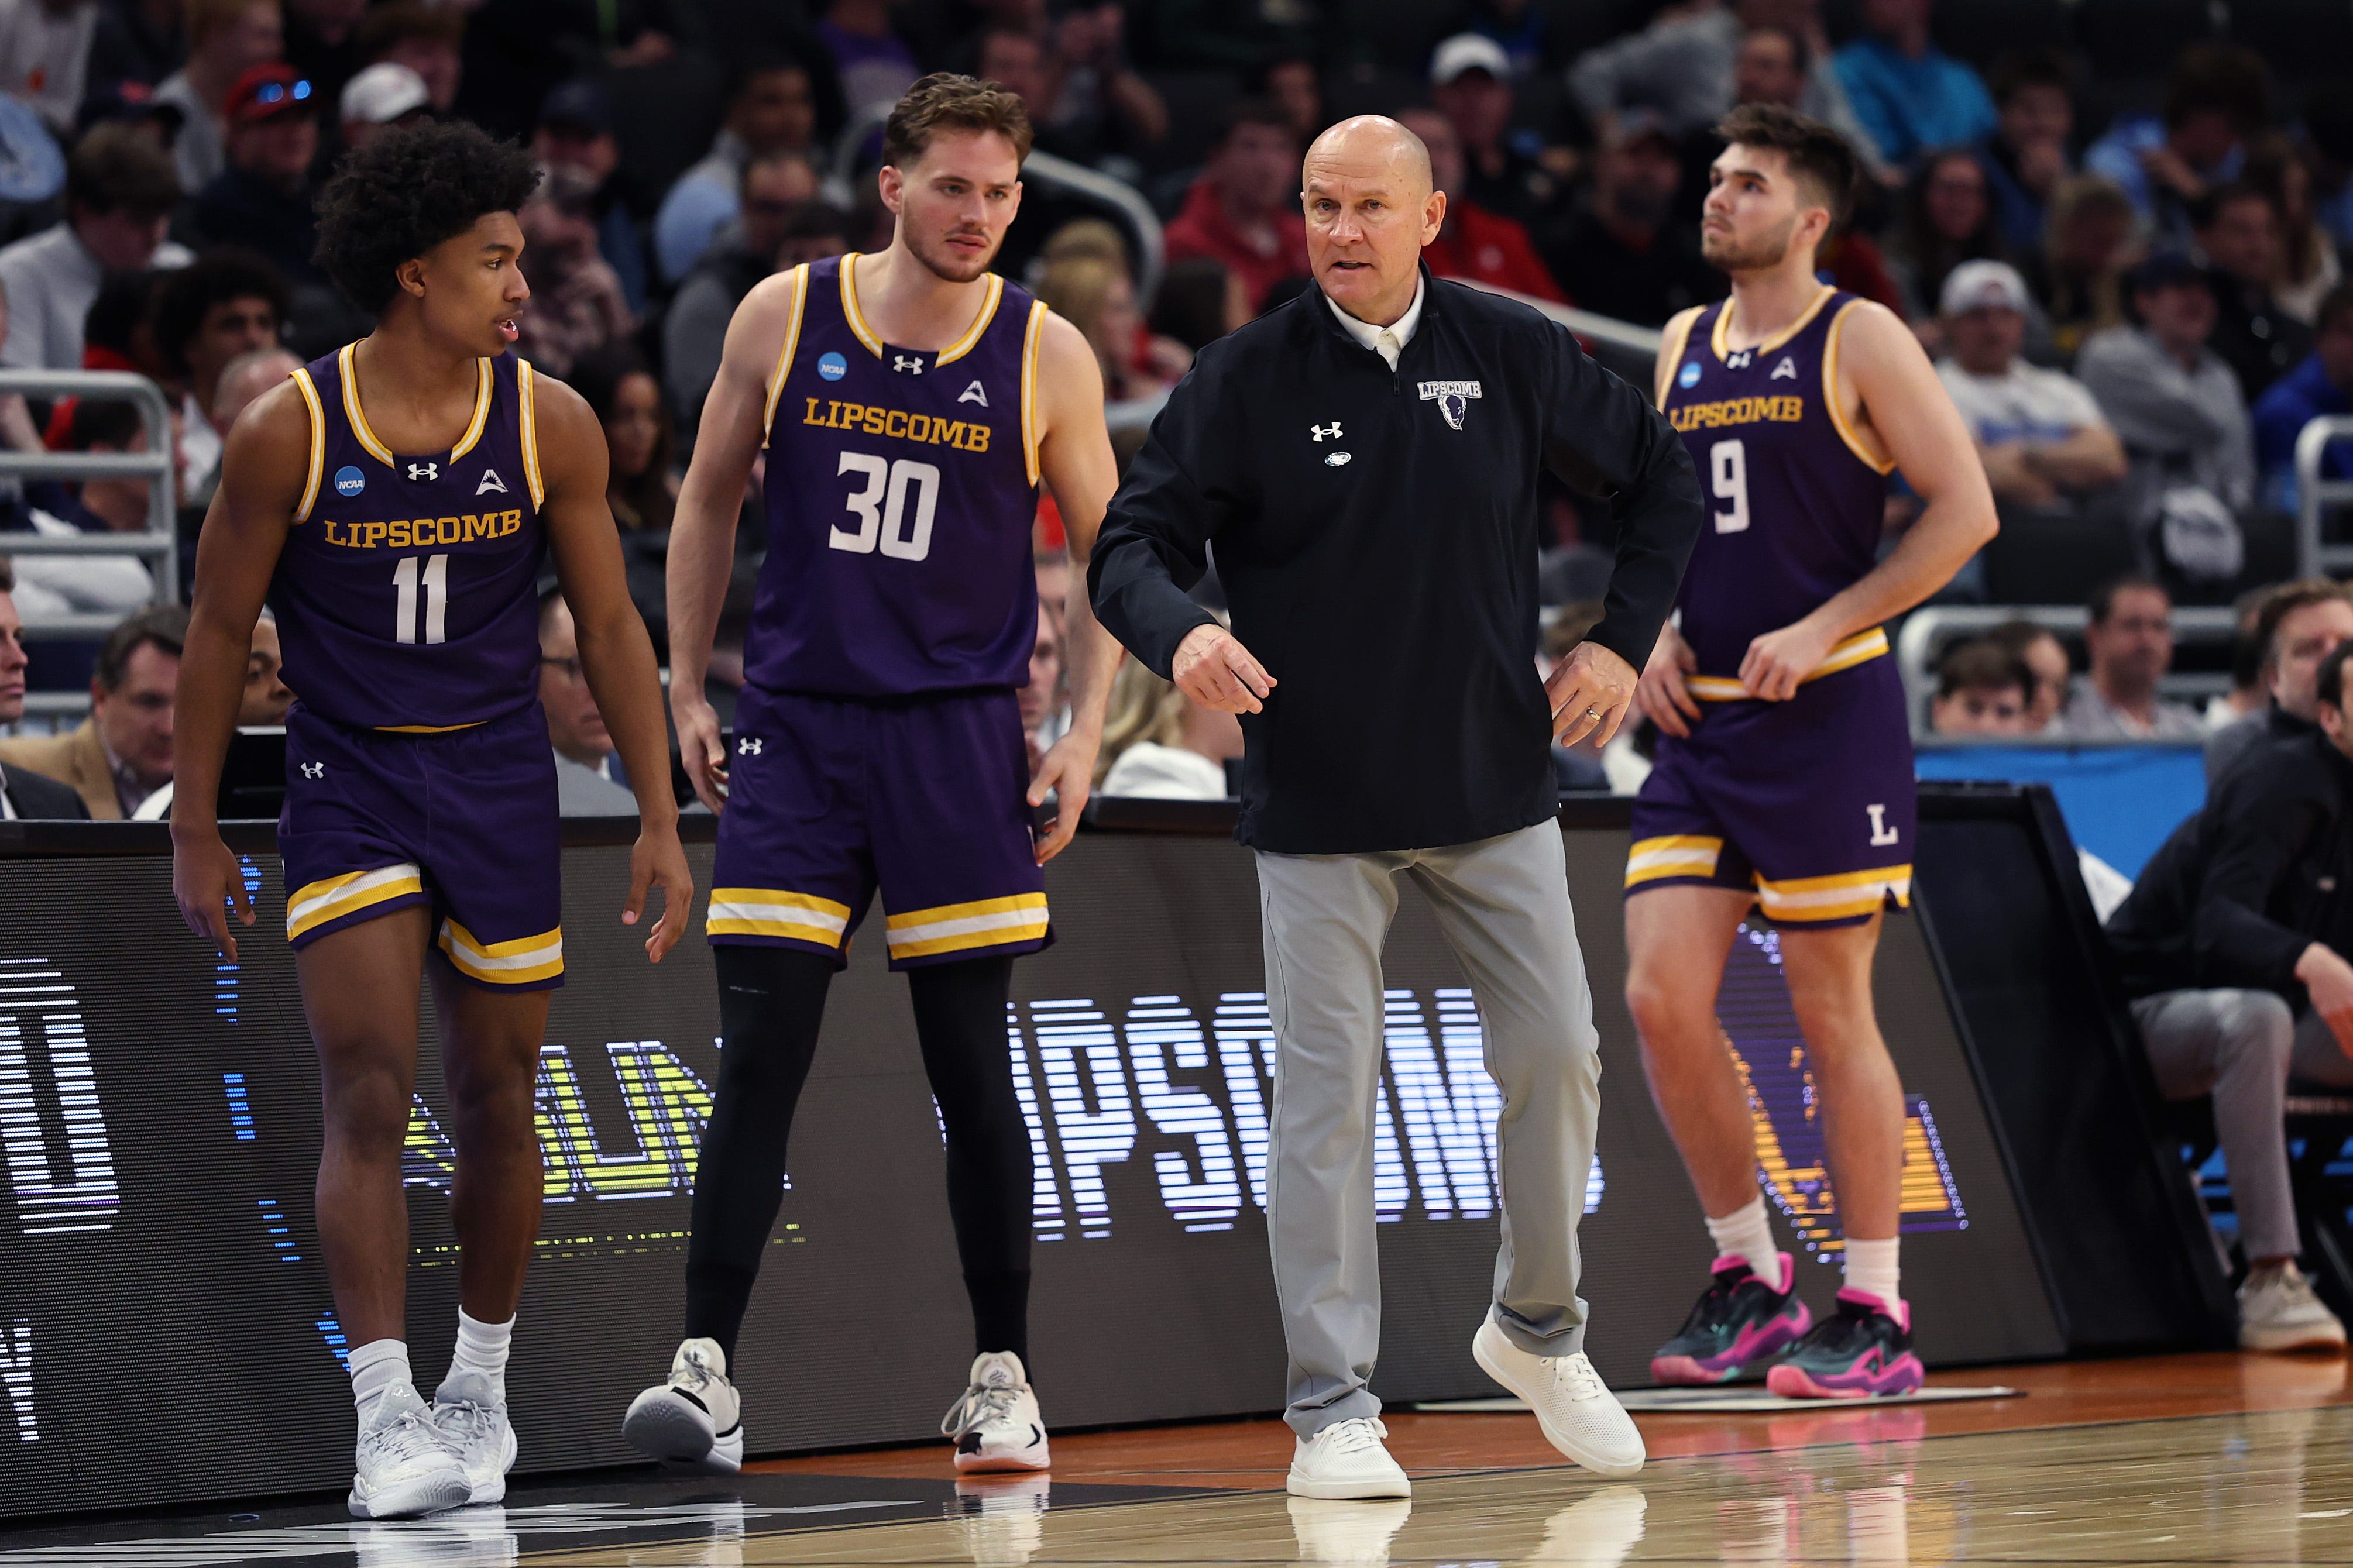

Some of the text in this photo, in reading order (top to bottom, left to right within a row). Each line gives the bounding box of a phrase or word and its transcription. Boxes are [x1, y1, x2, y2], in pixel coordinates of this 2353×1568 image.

[821, 364, 844, 375] NCAA
[1418, 381, 1482, 400] LIPSCOMB
[803, 397, 991, 453] LIPSCOMB
[1670, 396, 1804, 432] LIPSCOMB
[338, 480, 363, 490] NCAA
[1710, 438, 1750, 535] 9
[829, 450, 940, 562] 30
[324, 508, 521, 548] LIPSCOMB
[392, 553, 449, 645] 11
[1866, 804, 1899, 847] L
